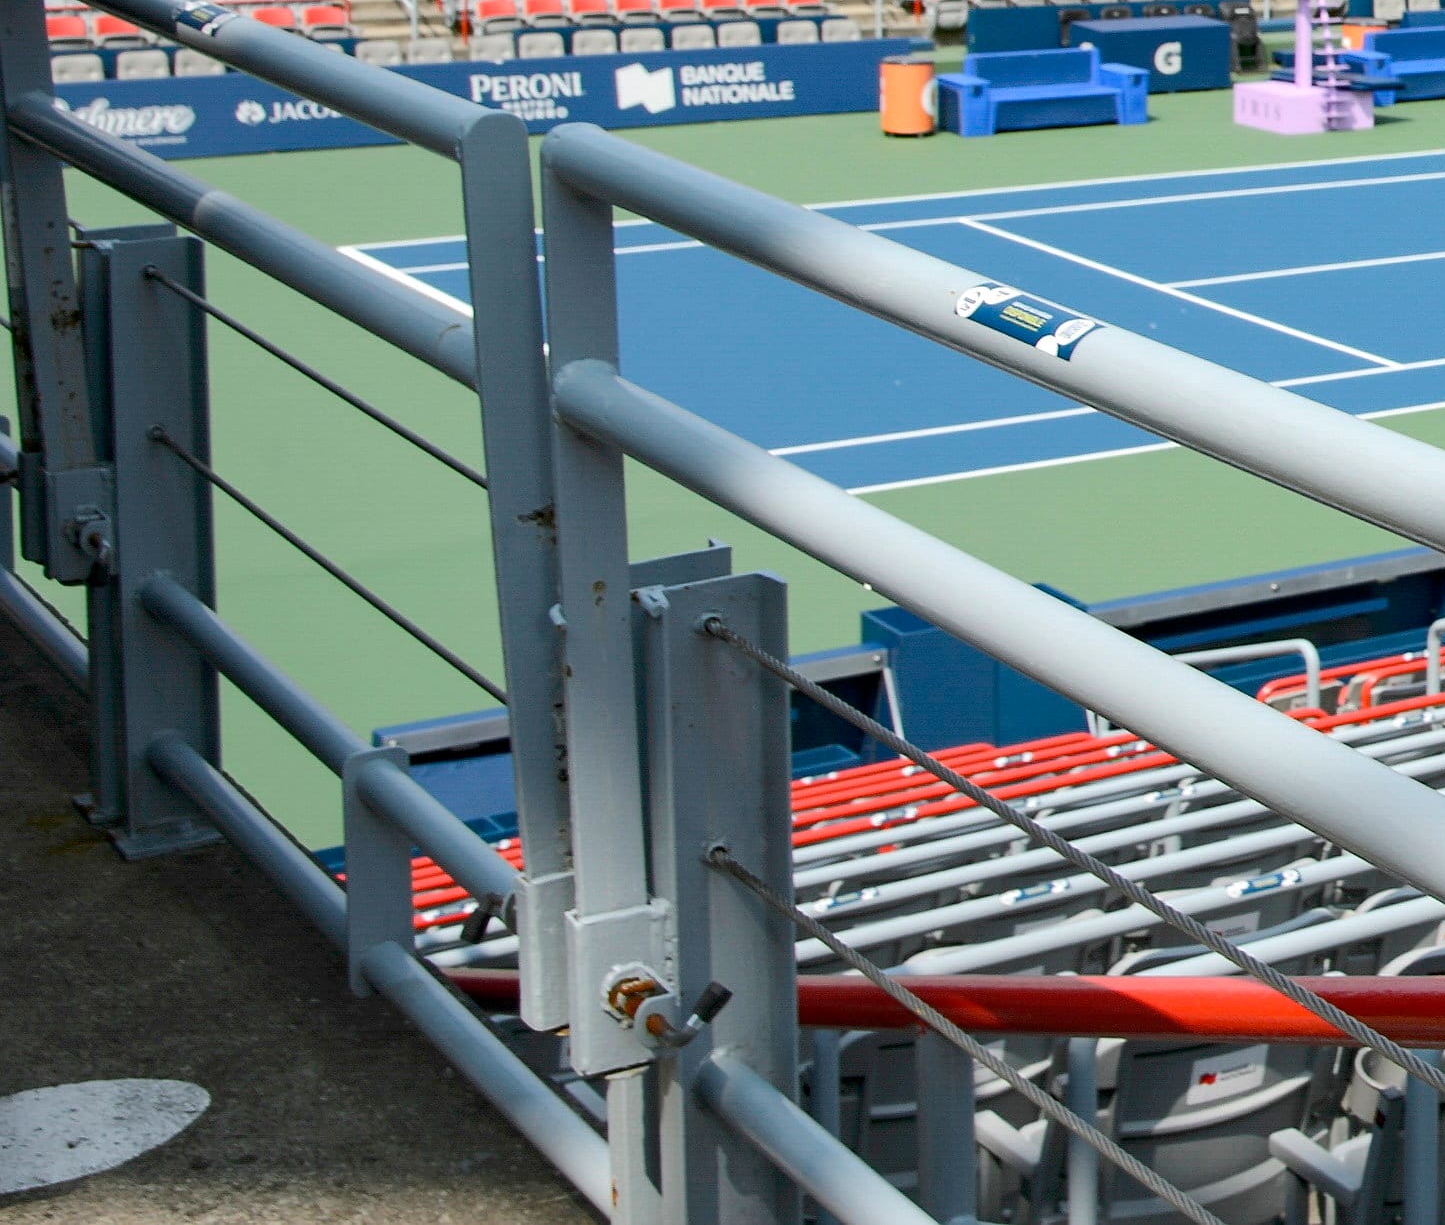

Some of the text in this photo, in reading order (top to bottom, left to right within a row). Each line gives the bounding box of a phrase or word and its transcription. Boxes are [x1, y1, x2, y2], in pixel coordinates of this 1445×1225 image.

[469, 71, 587, 103] PERONI
[680, 61, 766, 86] BANQUE
[681, 80, 796, 107] NATIONALE
